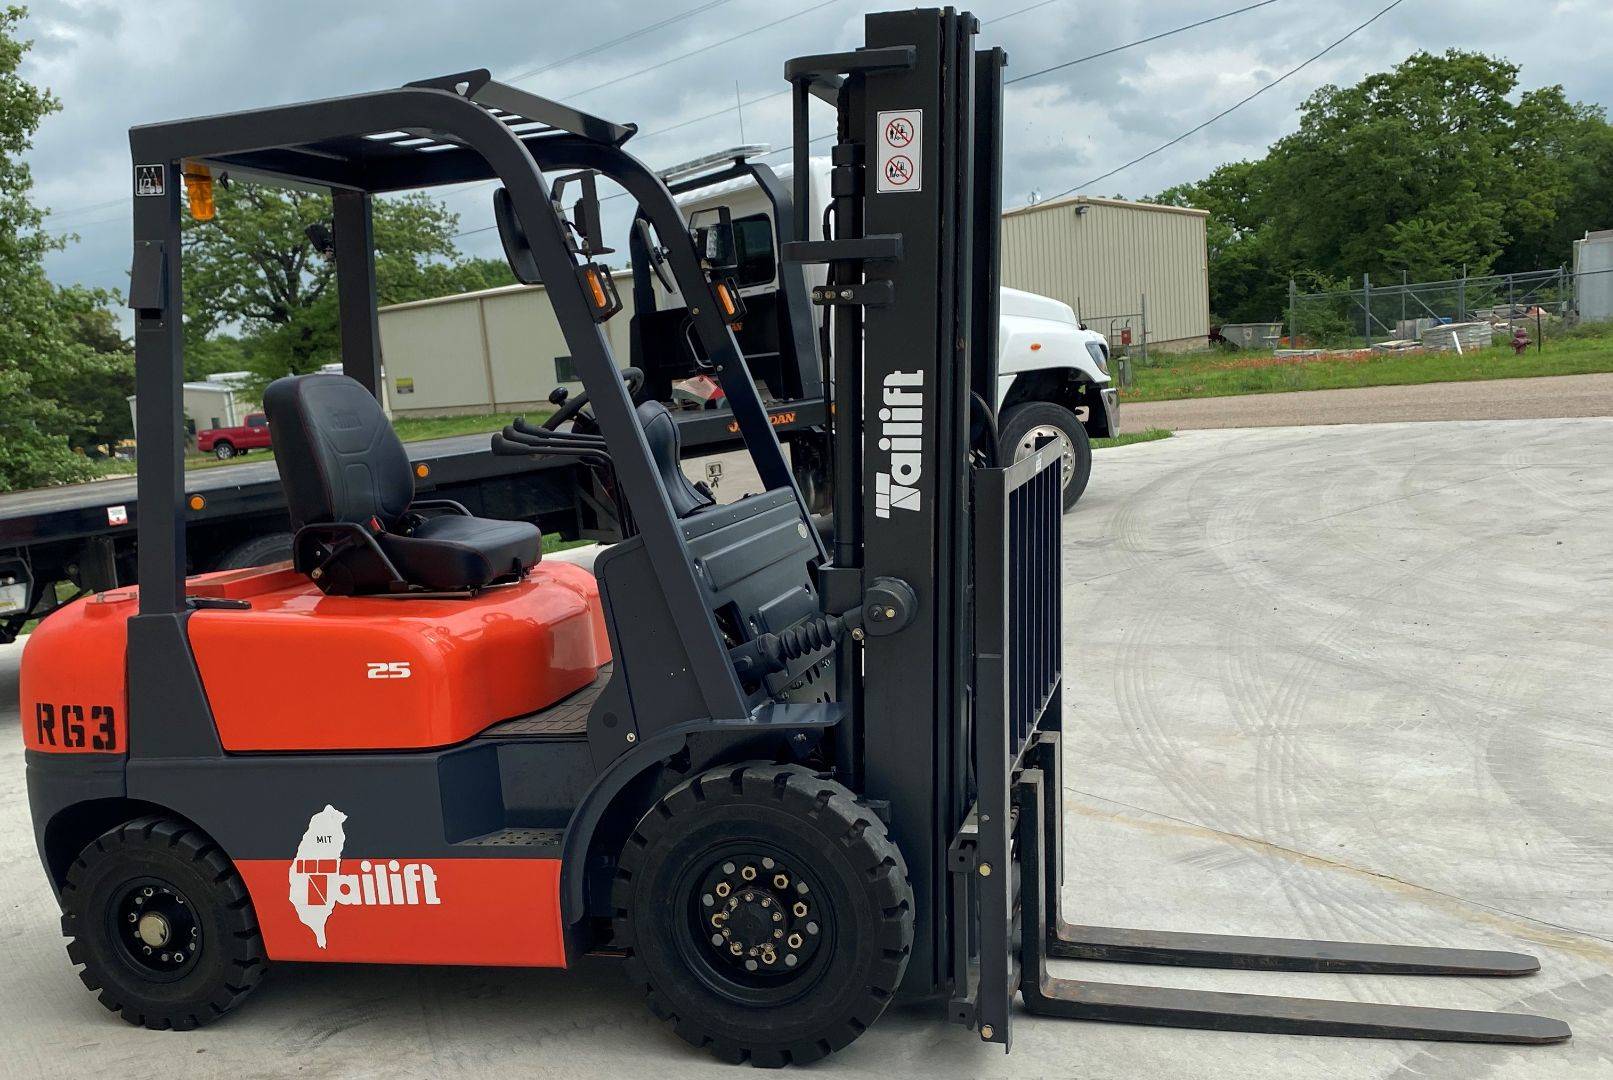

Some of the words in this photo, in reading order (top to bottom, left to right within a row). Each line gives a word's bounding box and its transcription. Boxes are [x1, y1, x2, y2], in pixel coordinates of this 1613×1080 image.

[876, 369, 924, 519] Tailift
[367, 662, 411, 679] 25
[36, 703, 117, 750] RG3
[316, 835, 332, 843] MIT
[296, 859, 441, 906] Tailift
